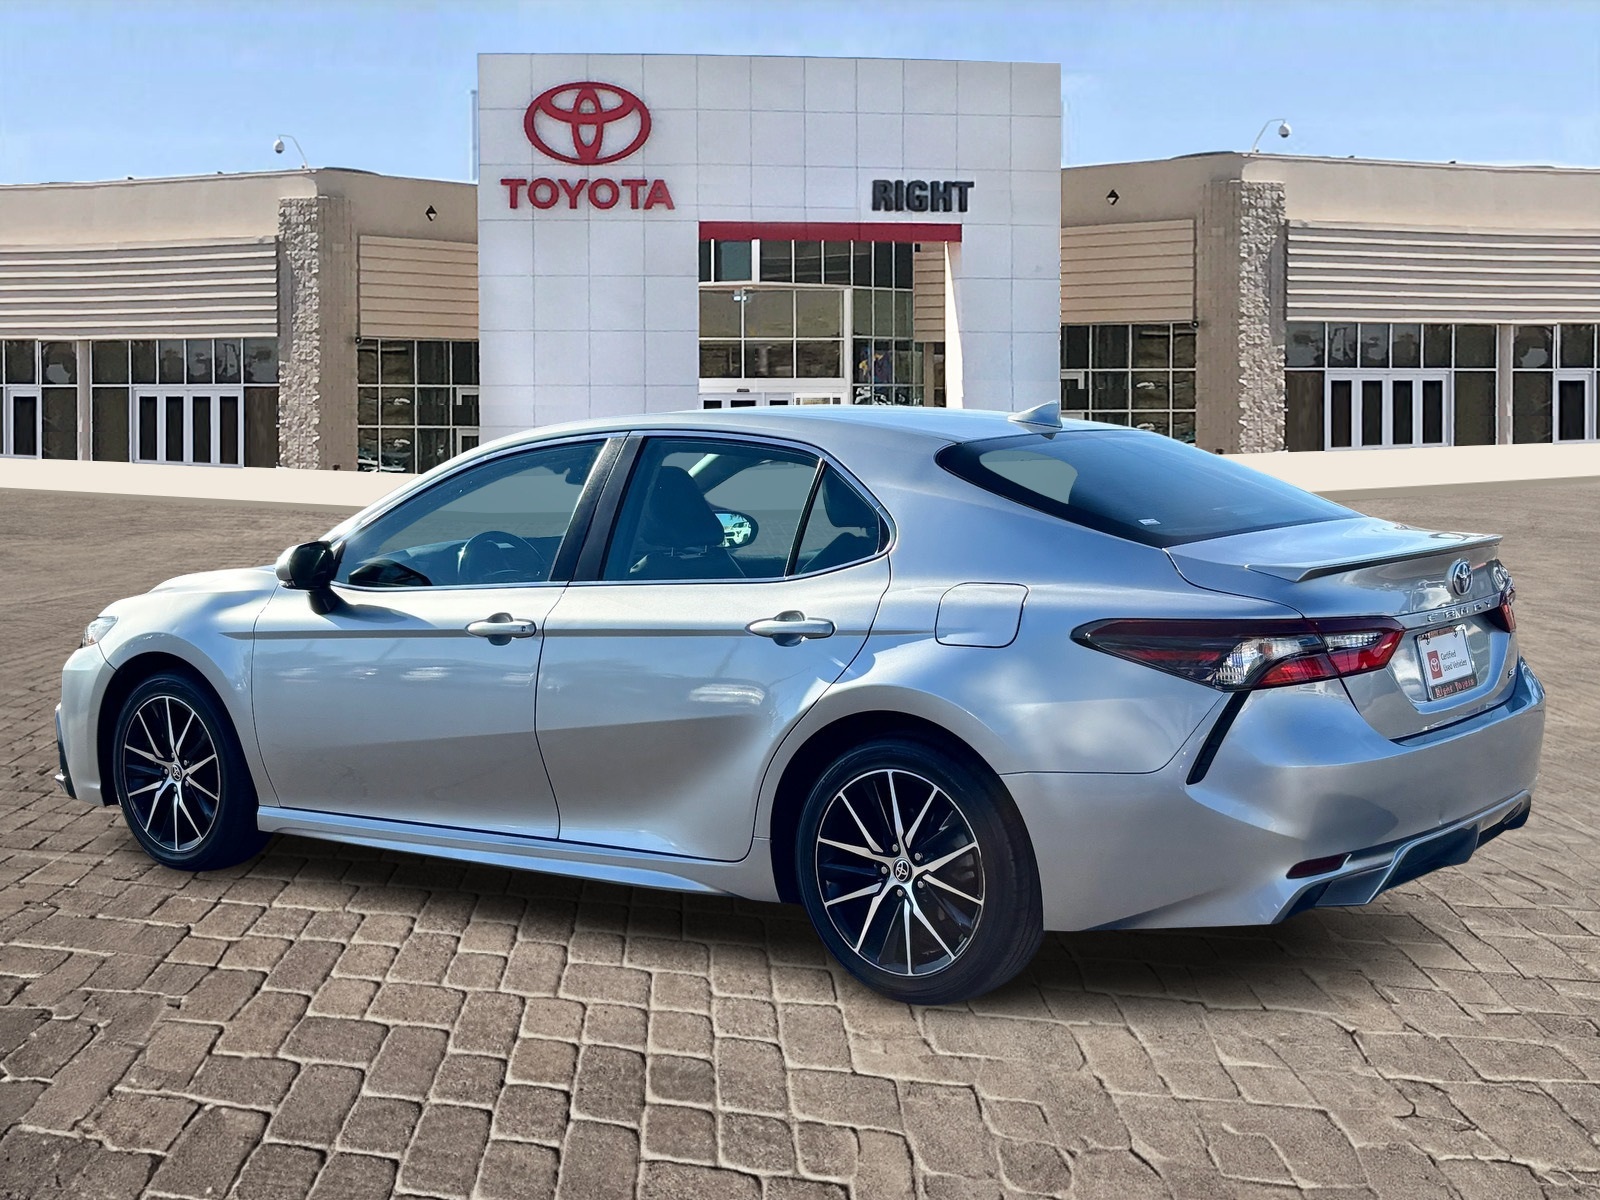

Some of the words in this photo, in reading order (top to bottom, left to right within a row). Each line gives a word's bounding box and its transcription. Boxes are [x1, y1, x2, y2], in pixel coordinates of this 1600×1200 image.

[500, 178, 675, 209] TOYOTA
[872, 179, 974, 212] RIGHT
[1441, 650, 1457, 661] Certified
[1443, 663, 1453, 672] Used
[1453, 659, 1467, 670] Vehicles
